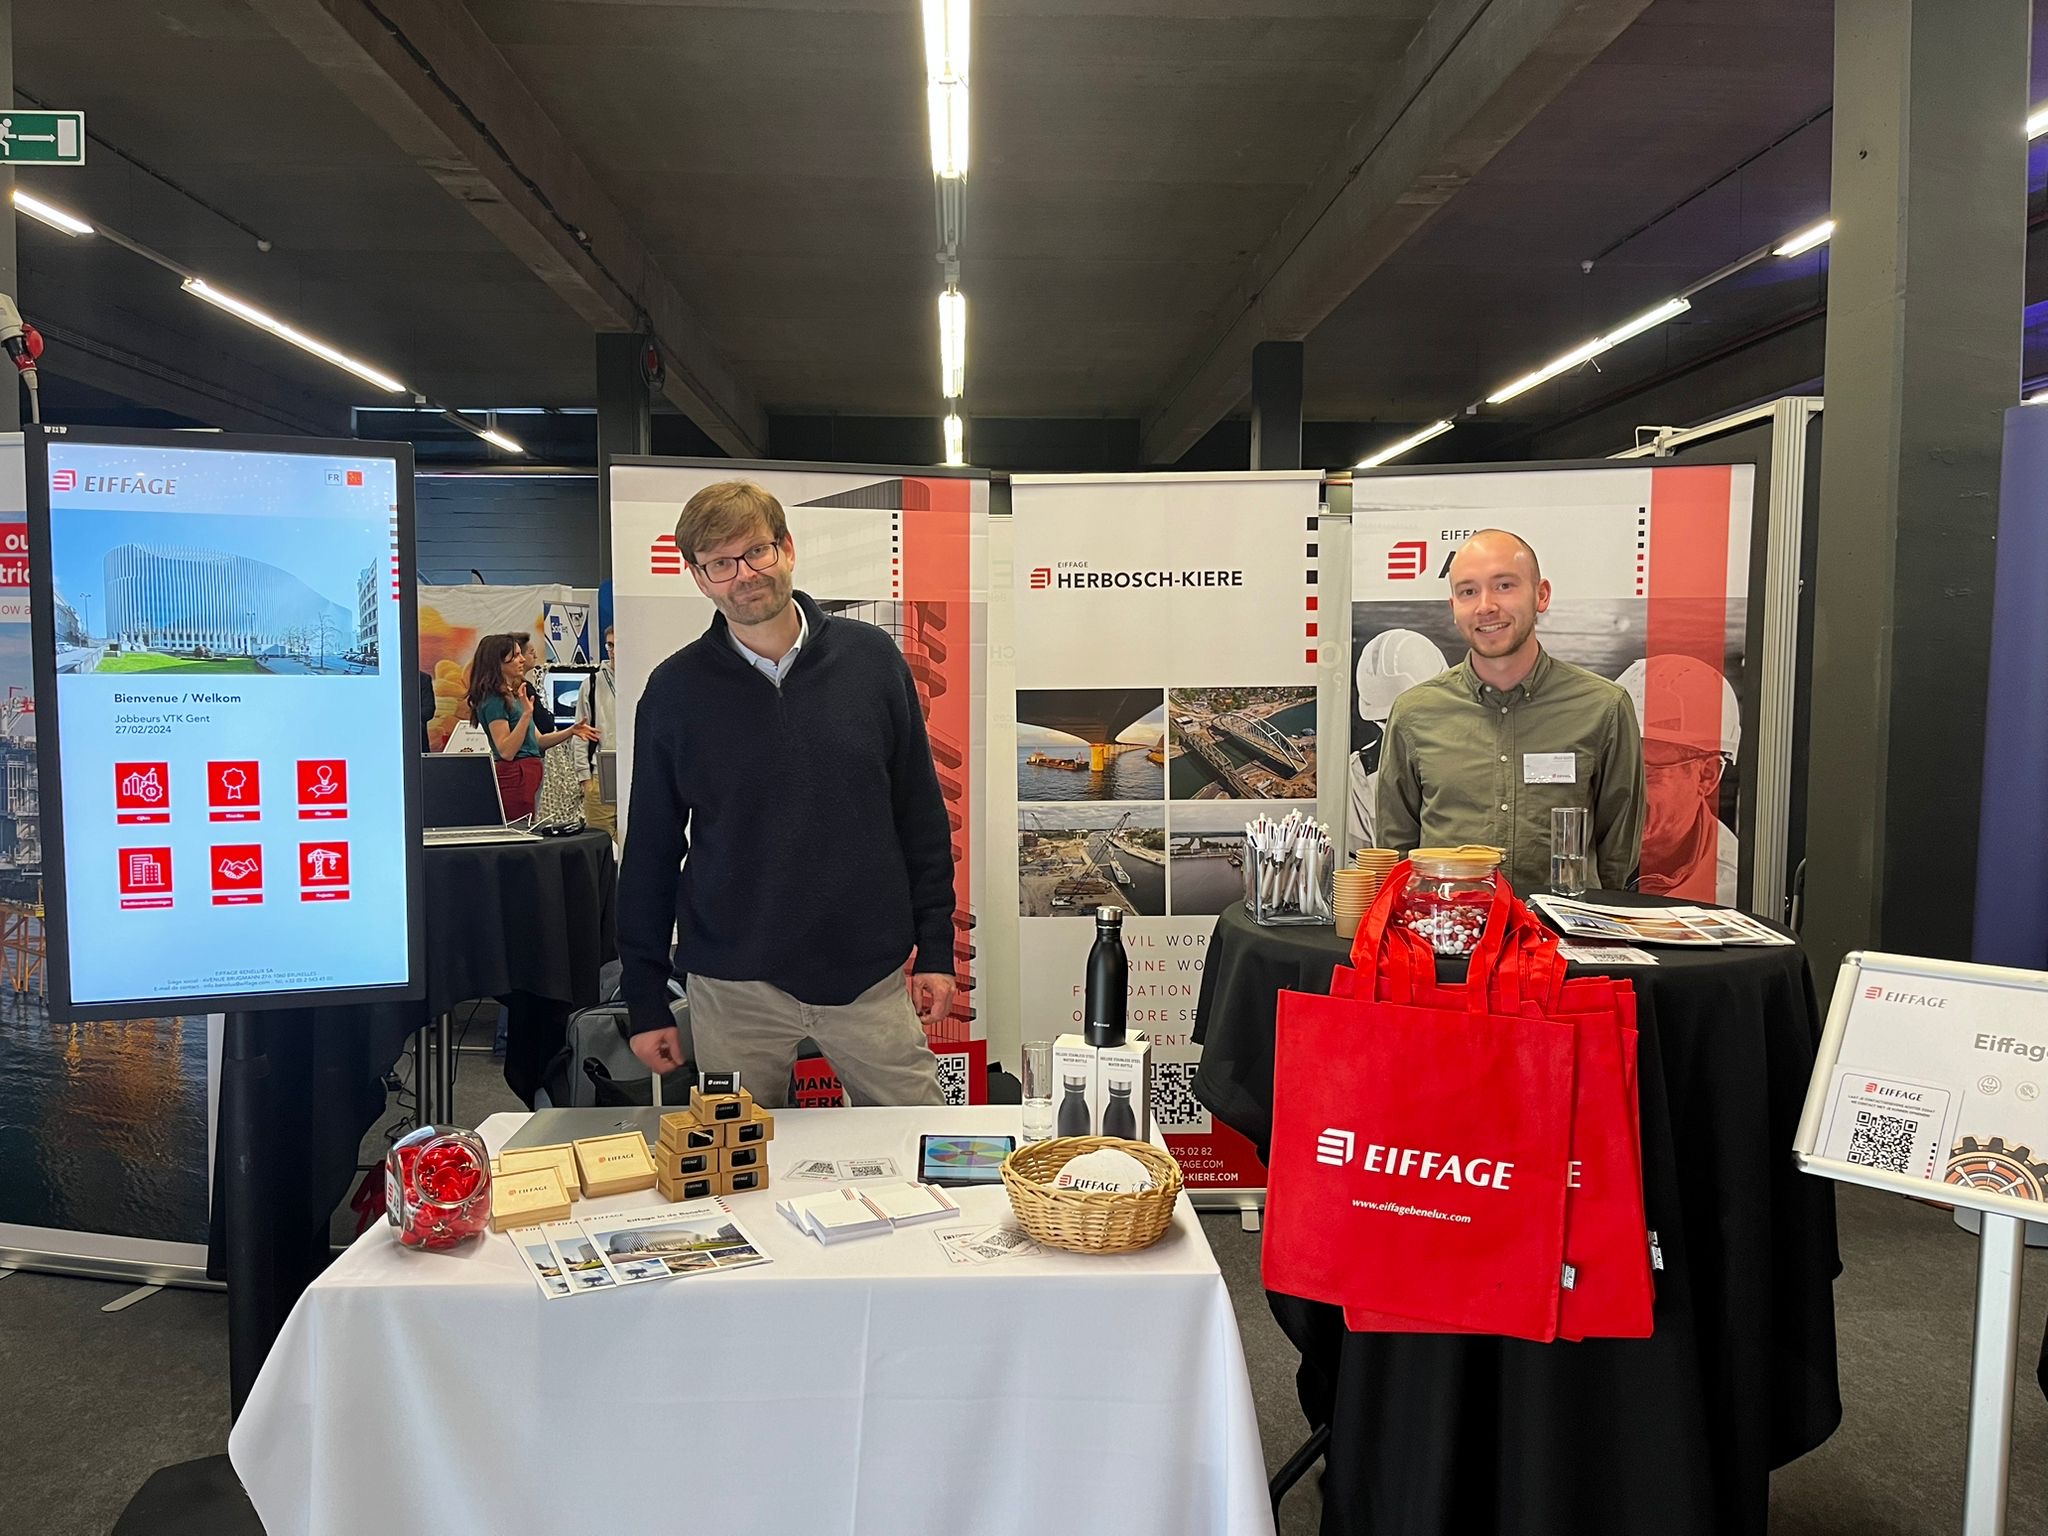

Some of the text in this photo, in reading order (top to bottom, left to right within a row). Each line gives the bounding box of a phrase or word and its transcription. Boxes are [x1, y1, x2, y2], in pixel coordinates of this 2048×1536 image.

[327, 473, 340, 481] FR
[84, 475, 177, 495] EIFFAGE
[1057, 561, 1088, 569] EIFFAGE
[1057, 570, 1243, 589] HERBOSCH-KIERE
[0, 605, 21, 615] ow
[114, 692, 179, 704] Bienvenue
[191, 692, 242, 704] Welkom
[114, 713, 211, 724] Jobbeurs VTK Gent
[115, 725, 172, 735] 27/02/2024
[1167, 934, 1213, 946] WOR
[1127, 959, 1204, 971] RINE WO
[1885, 991, 1949, 1009] EIFFAGE
[1179, 1009, 1197, 1021] SE
[1974, 1033, 2048, 1062] Eiffag
[1878, 1087, 1924, 1101] EIFFAGE
[1187, 1147, 1198, 1156] 02
[1201, 1147, 1212, 1156] 82
[1179, 1160, 1224, 1169] FAGE.COM
[1364, 1144, 1515, 1190] EIFFAGE
[1074, 1178, 1121, 1193] EIFFAGE
[1352, 1199, 1471, 1224] www.eiffagebenelux.com
